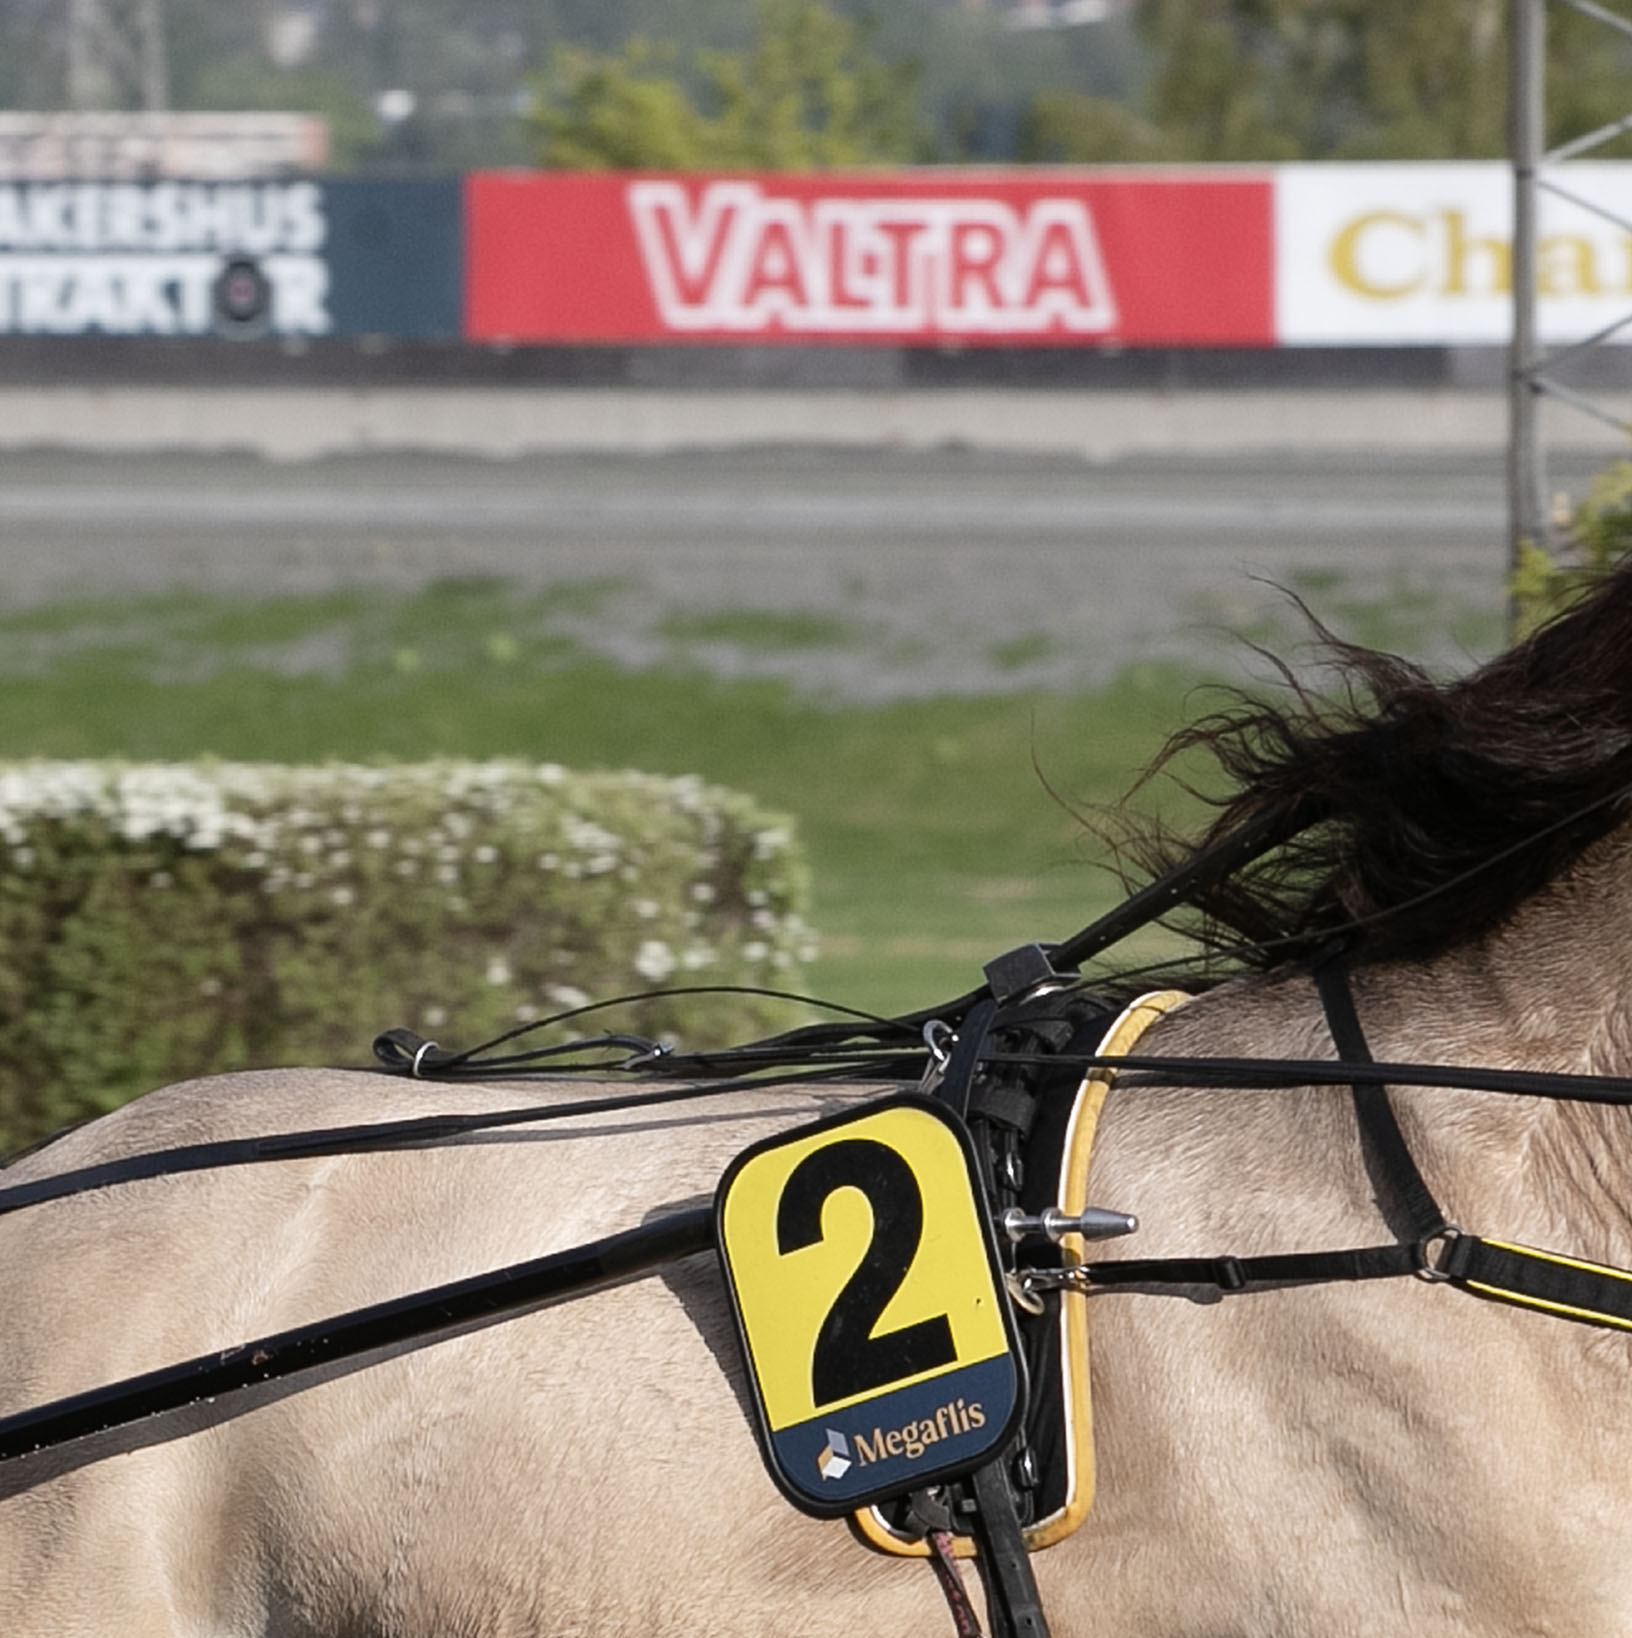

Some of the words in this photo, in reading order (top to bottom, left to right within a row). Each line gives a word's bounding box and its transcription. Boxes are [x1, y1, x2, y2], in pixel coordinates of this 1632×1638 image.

[625, 182, 1117, 332] VALTRA
[776, 1139, 958, 1408] 2
[853, 1398, 987, 1466] Megaflis
